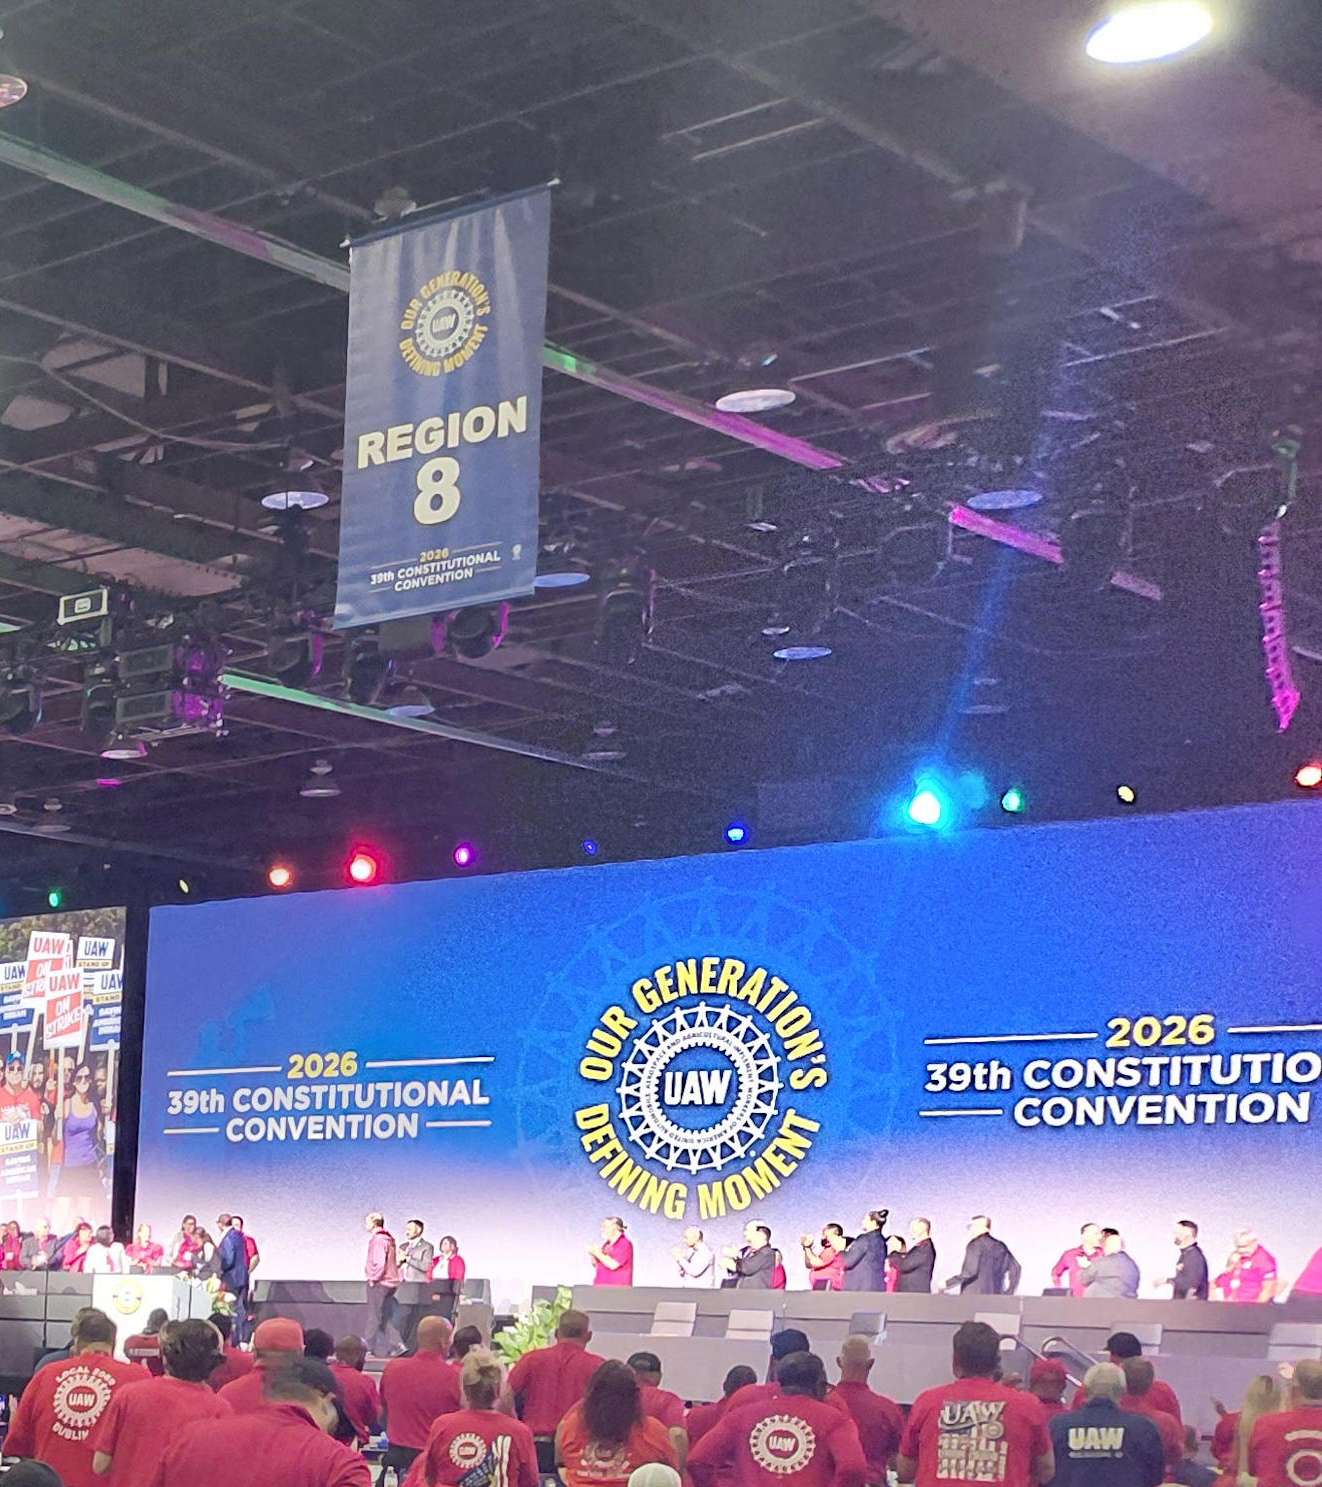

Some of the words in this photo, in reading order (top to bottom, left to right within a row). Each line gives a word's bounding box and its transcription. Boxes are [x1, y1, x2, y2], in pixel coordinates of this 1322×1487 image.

[400, 299, 423, 330] OUR
[443, 323, 488, 373] MOMENT
[357, 395, 527, 470] REGION
[413, 456, 461, 525] 8
[370, 570, 395, 585] 39th
[397, 550, 501, 579] CONSTITUTIONAL
[419, 547, 450, 563] 2026
[394, 568, 474, 592] CONVENTION
[33, 937, 65, 954] UAW
[84, 940, 109, 957] UAW
[49, 973, 81, 992] UAW
[579, 1005, 638, 1082] OUR
[631, 956, 828, 1090] GENERATION'S
[1105, 1014, 1216, 1048] 2026
[286, 1052, 358, 1079] 2026
[924, 1062, 1011, 1092] 39th
[167, 1089, 225, 1116] 39th
[232, 1079, 490, 1113] CONSTITUTIONAL
[664, 1069, 733, 1105] UAW
[1013, 1091, 1311, 1127] CONVENTION
[5, 1122, 30, 1140] UAW
[225, 1113, 419, 1142] CONVENTION
[575, 1103, 688, 1220] DEFINING
[697, 1107, 821, 1220] MOMENT
[55, 1365, 90, 1383] LOCAL
[68, 1393, 96, 1407] UAW
[941, 1401, 1006, 1426] UAW
[769, 1436, 796, 1452] UAW
[1068, 1427, 1125, 1450] UAW
